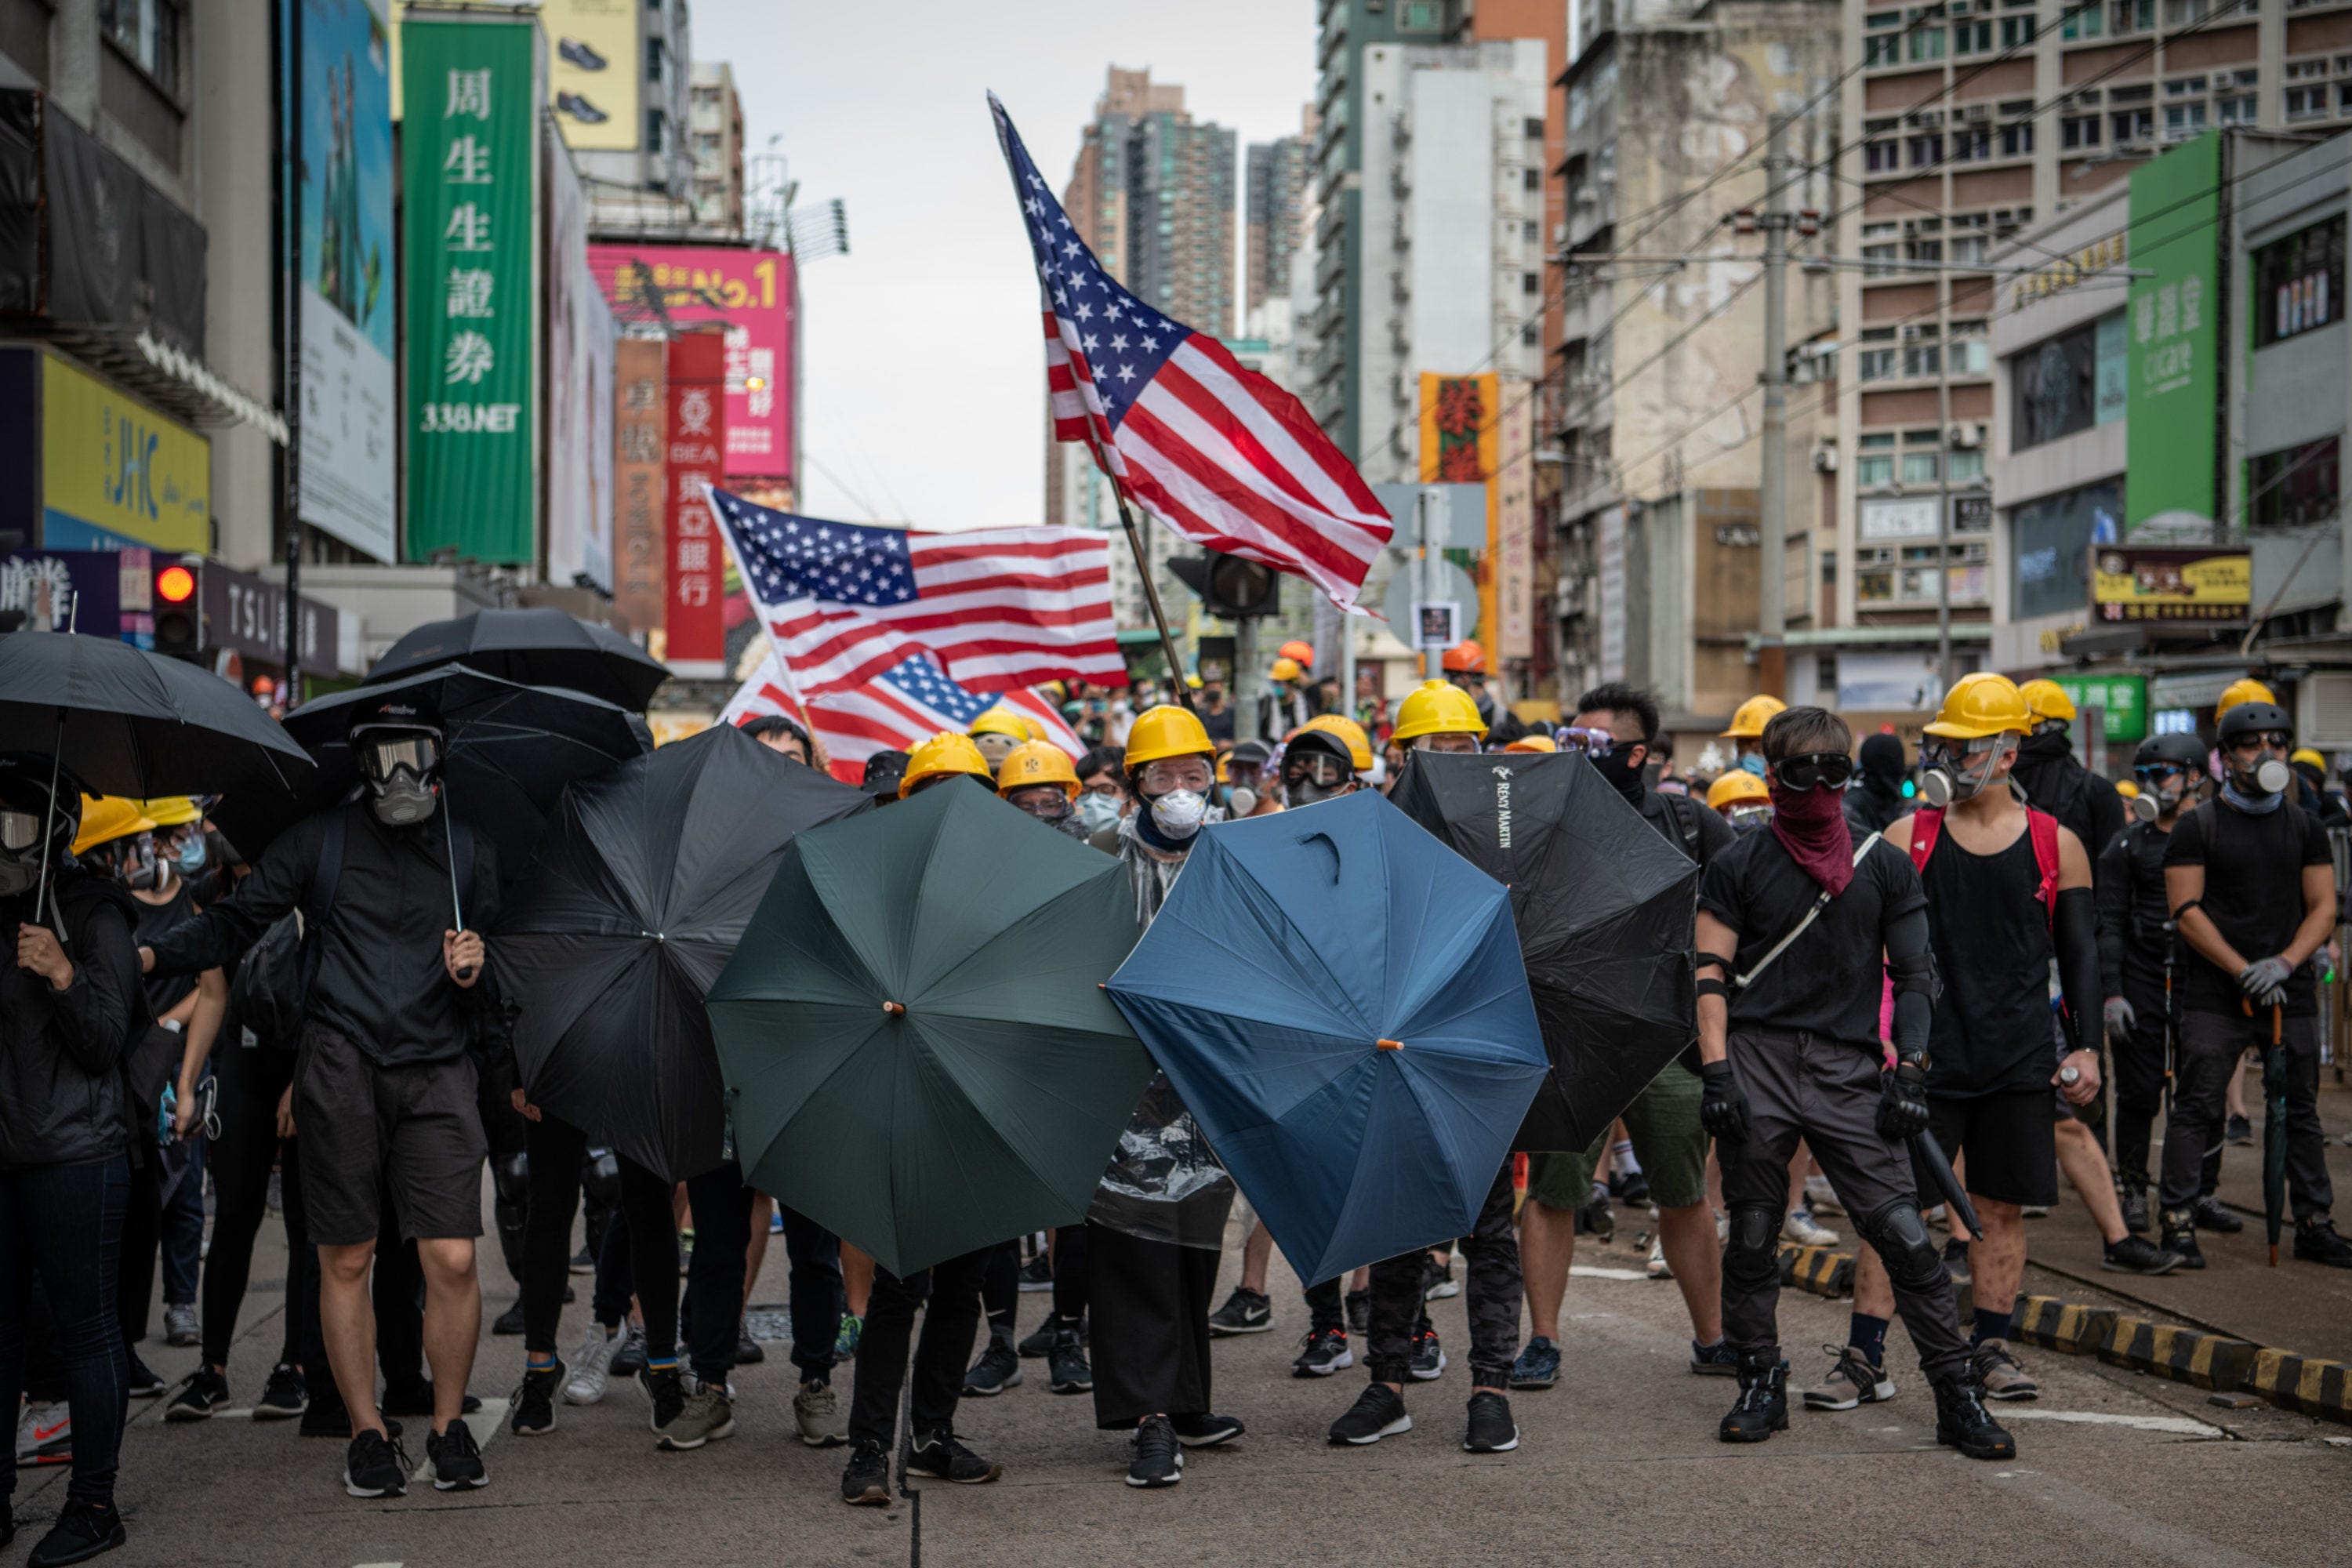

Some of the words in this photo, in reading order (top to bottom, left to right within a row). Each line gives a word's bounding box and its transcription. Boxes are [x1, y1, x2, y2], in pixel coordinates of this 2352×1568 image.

[443, 67, 495, 385] 周生生證券
[114, 415, 160, 523] JHC
[669, 441, 720, 465] BEA
[677, 470, 712, 608] 東亞銀行
[228, 582, 269, 643] TSL
[1498, 810, 1512, 848] MARTIN
